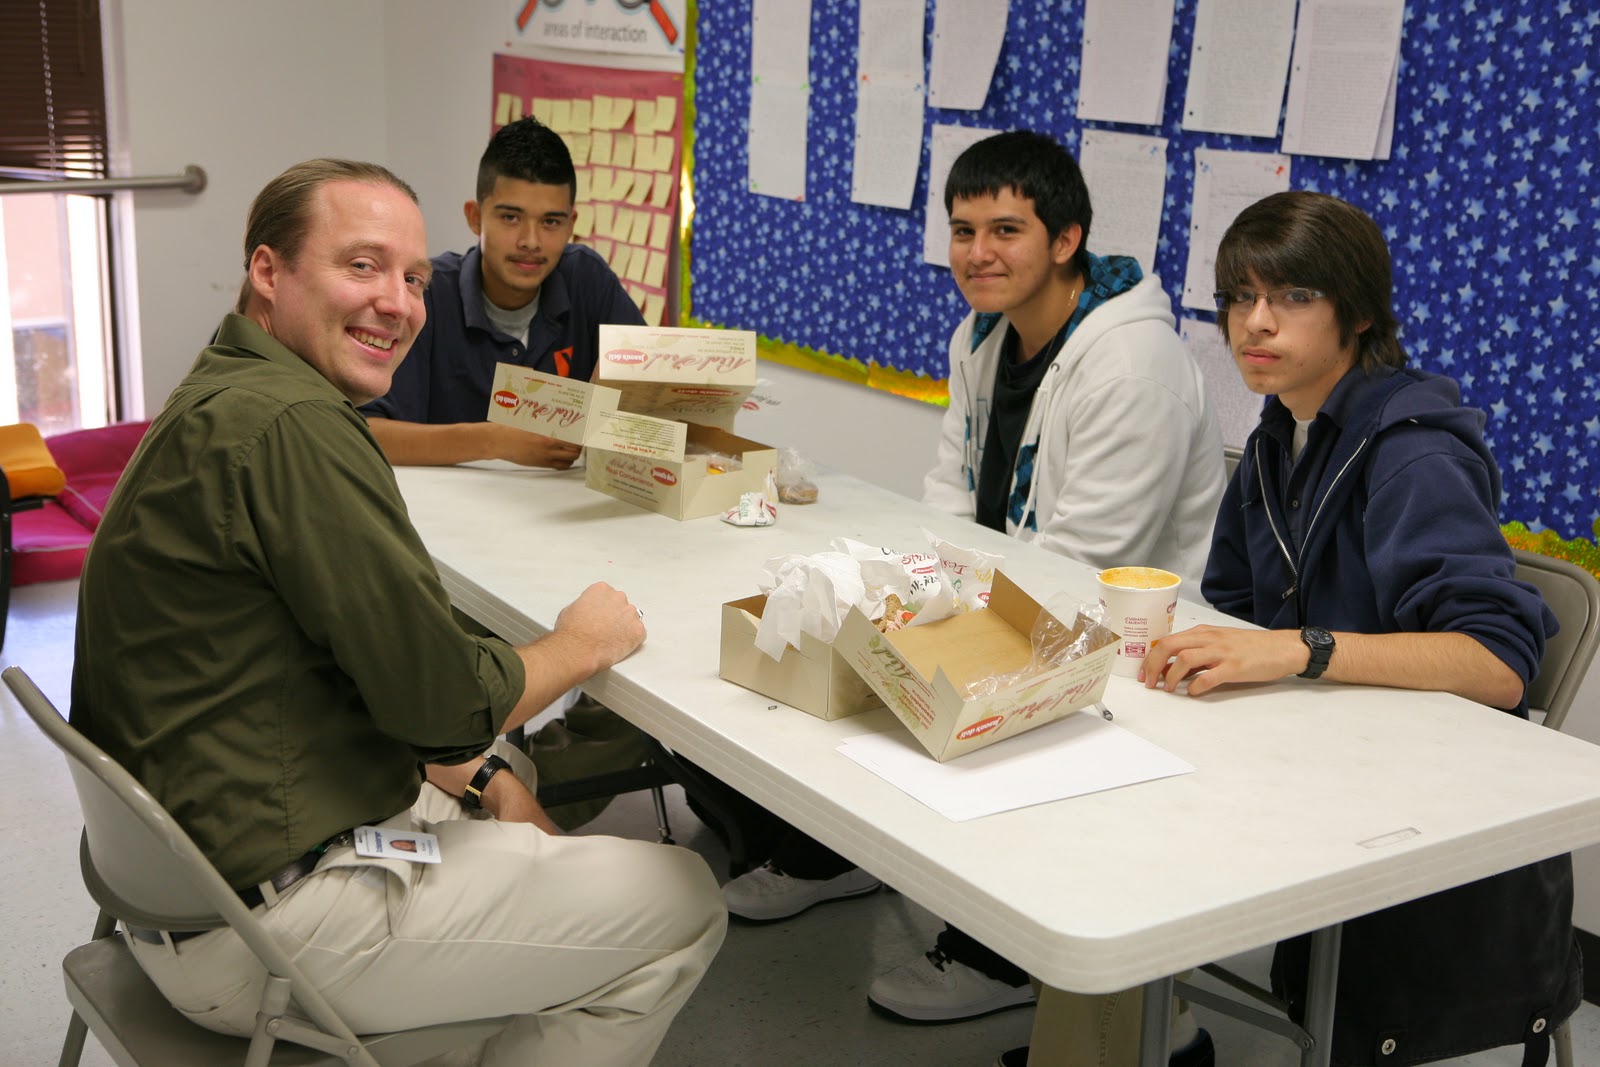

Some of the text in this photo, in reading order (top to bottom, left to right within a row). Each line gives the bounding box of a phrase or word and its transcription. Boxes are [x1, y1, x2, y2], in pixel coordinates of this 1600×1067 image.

[544, 19, 647, 43] areas of interaction
[608, 353, 646, 363] jason's deli
[871, 647, 912, 680] Real
[959, 717, 1002, 740] jason's deli
